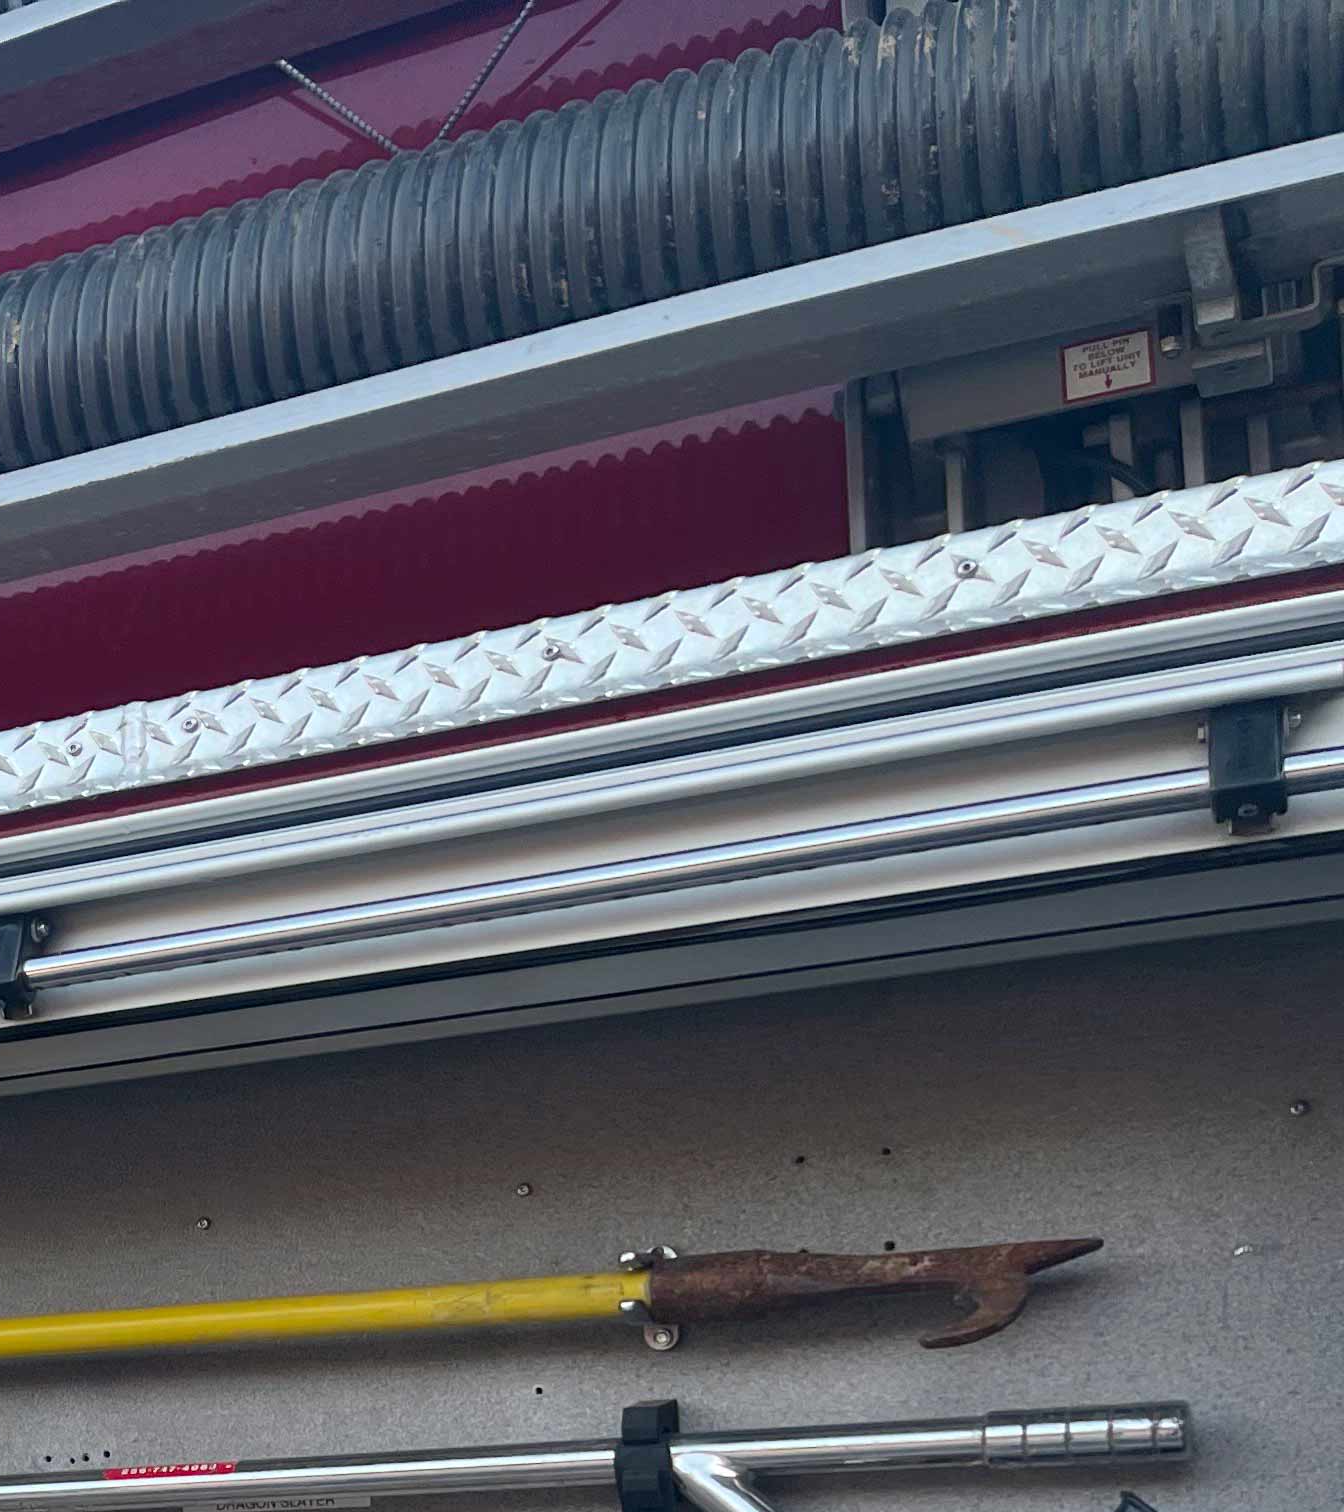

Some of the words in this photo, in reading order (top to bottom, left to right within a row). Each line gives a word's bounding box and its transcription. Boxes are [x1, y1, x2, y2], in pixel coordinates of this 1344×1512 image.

[1082, 340, 1110, 353] PULL
[1088, 346, 1126, 360] BELOW
[1073, 363, 1087, 372] TO
[1090, 357, 1114, 369] LIFT
[1078, 360, 1136, 379] MANUALLY
